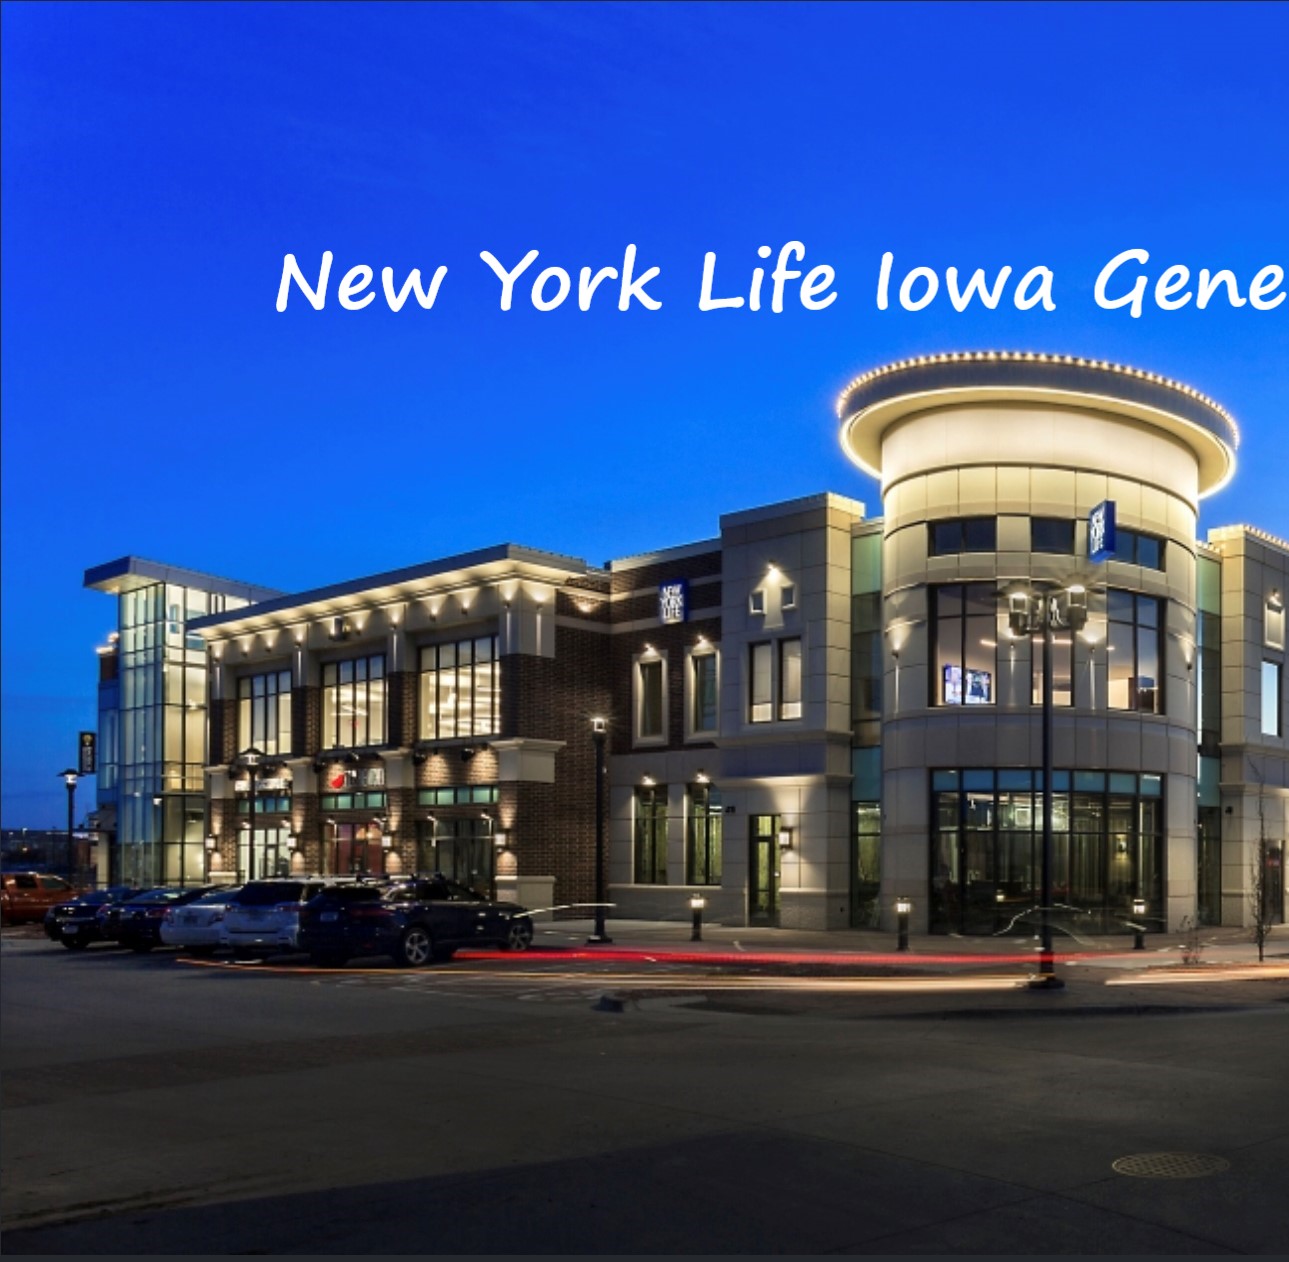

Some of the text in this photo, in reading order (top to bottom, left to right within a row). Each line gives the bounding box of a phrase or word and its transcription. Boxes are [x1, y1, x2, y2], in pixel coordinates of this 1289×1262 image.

[662, 584, 683, 598] NEW
[660, 594, 684, 608] YORK
[662, 605, 683, 619] LIFE
